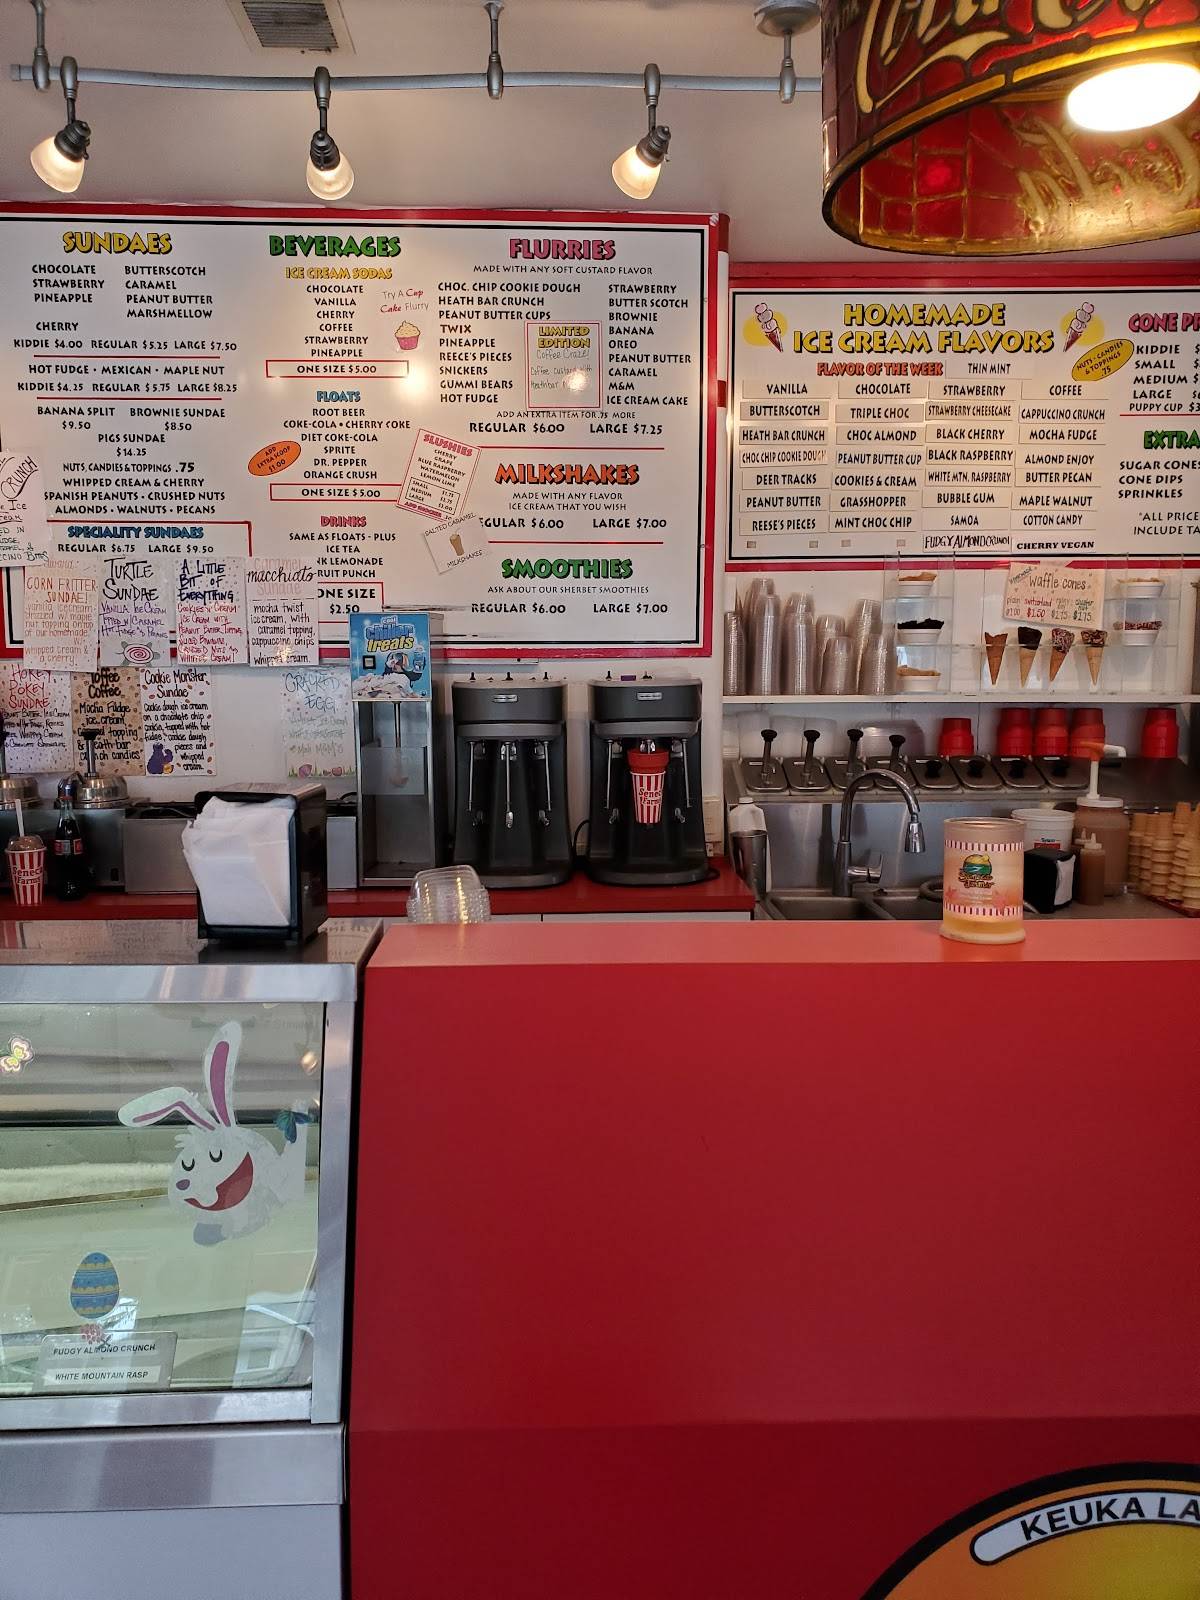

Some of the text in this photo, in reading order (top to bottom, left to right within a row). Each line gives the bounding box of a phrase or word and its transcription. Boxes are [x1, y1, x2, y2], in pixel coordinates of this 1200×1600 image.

[63, 231, 172, 255] SUNDAES
[269, 235, 402, 257] BEVERAGES
[509, 239, 616, 260] FLURRIES
[32, 265, 96, 274] CHOCOLATE
[125, 266, 206, 276] BUTTERSCOTCH
[286, 267, 392, 279] ICE CREAM SODAS
[473, 265, 500, 273] MADE
[503, 265, 527, 273] WITH
[576, 266, 616, 274] CUSTARD
[619, 266, 652, 275] FLAVOR
[33, 279, 105, 288] STRAWBERRY
[125, 280, 177, 289] CARAMEL
[307, 285, 363, 293] CHOCOLATE
[608, 285, 677, 294] STRAWBERRY
[34, 294, 92, 303] PINEAPPLE
[126, 295, 213, 304] PEANUT BUTTER
[127, 309, 212, 318] MARSHMELLOW
[609, 313, 658, 322] BROWNIE
[843, 304, 1005, 327] HOMEMADE
[36, 322, 78, 331] CHERRY
[1129, 313, 1178, 332] CONE
[441, 325, 472, 334] TWIX
[539, 327, 590, 336] LIMITED
[609, 326, 654, 335] BANANA
[14, 339, 237, 351] KIDDIE $4.00 REGULAR $5.25 LARGE $7.50
[304, 336, 368, 344] STRAWBERRY
[439, 339, 495, 347] PINEAPPLE
[538, 338, 590, 348] EDITION
[609, 340, 637, 349] OREO
[794, 330, 1054, 353] ICE CREAM FLAVORS
[311, 349, 363, 357] PINEAPPLE
[1137, 345, 1180, 354] KIDDIE
[297, 365, 320, 373] ONE
[817, 363, 943, 376] FLAVOR OF THE WEEK
[968, 364, 1010, 374] THIN MINT
[1135, 360, 1175, 369] SMALL
[439, 366, 488, 375] SNICKERS
[609, 368, 658, 377] CARAMEL
[1133, 375, 1187, 384] MEDIUM
[609, 382, 635, 390] M&M
[767, 384, 808, 394] VANILLA
[855, 384, 911, 394] CHOCOLATE
[944, 385, 1005, 396] STRAWBERRY
[1050, 385, 1082, 395] COFFEE
[316, 391, 361, 402] FLOATS
[441, 394, 498, 403] HOT FUDGE
[1133, 390, 1172, 399] LARGE
[37, 407, 115, 416] BANANA SPLIT
[130, 408, 225, 417] BROWNIE SUNDAE
[750, 406, 820, 416] BUTTERSCOTCH
[1129, 403, 1183, 412] PUPPY CUP
[851, 408, 909, 418] TRIPLE CHOC
[1021, 409, 1105, 420] CAPPUCCINO CRUNCH
[62, 421, 91, 430] $9.50
[165, 422, 192, 431] $8.50
[469, 423, 526, 433] REGULAR
[590, 424, 628, 434] LARGE
[634, 424, 662, 434] $7.25
[98, 434, 165, 443] PIGS SUNDAE
[937, 429, 1005, 439] BLACK CHERRY
[1029, 430, 1097, 440] MOCHA FUDGE
[324, 446, 356, 454] SPRITE
[424, 434, 473, 456] SLUSHIES
[116, 448, 146, 457] $14.25
[1119, 461, 1160, 470] SUGAR
[304, 471, 377, 479] ORANGE CRUSH
[495, 464, 640, 485] MILKSHAKES
[756, 474, 816, 485] DEER TRACKS
[1119, 475, 1183, 484] CONE DIPS
[937, 493, 994, 503] BUBBLE GUM
[1118, 490, 1183, 498] SPRINKLES
[840, 497, 906, 507] GRASSHOPPER
[1020, 496, 1092, 506] MAPLE WALNUT
[320, 516, 367, 527] DRINKS
[951, 515, 978, 525] SAMOA
[1023, 515, 1082, 525] COTTON CANDY
[68, 526, 204, 538] SPECIALITY SUNDAES
[1134, 526, 1183, 535] INCLUDE
[104, 555, 154, 581] TURTLE
[182, 559, 189, 574] A
[501, 558, 633, 579] SMOOTHIES
[247, 566, 317, 583] macchiato
[1029, 573, 1086, 590] waffle cones
[103, 578, 159, 601] SUNDAE
[367, 636, 414, 652] treats
[145, 671, 170, 684] Cookie
[88, 685, 121, 698] Coffee
[157, 686, 189, 698] Sundae
[120, 1343, 156, 1352] CRUNCH
[1020, 1496, 1145, 1541] KEUKA
